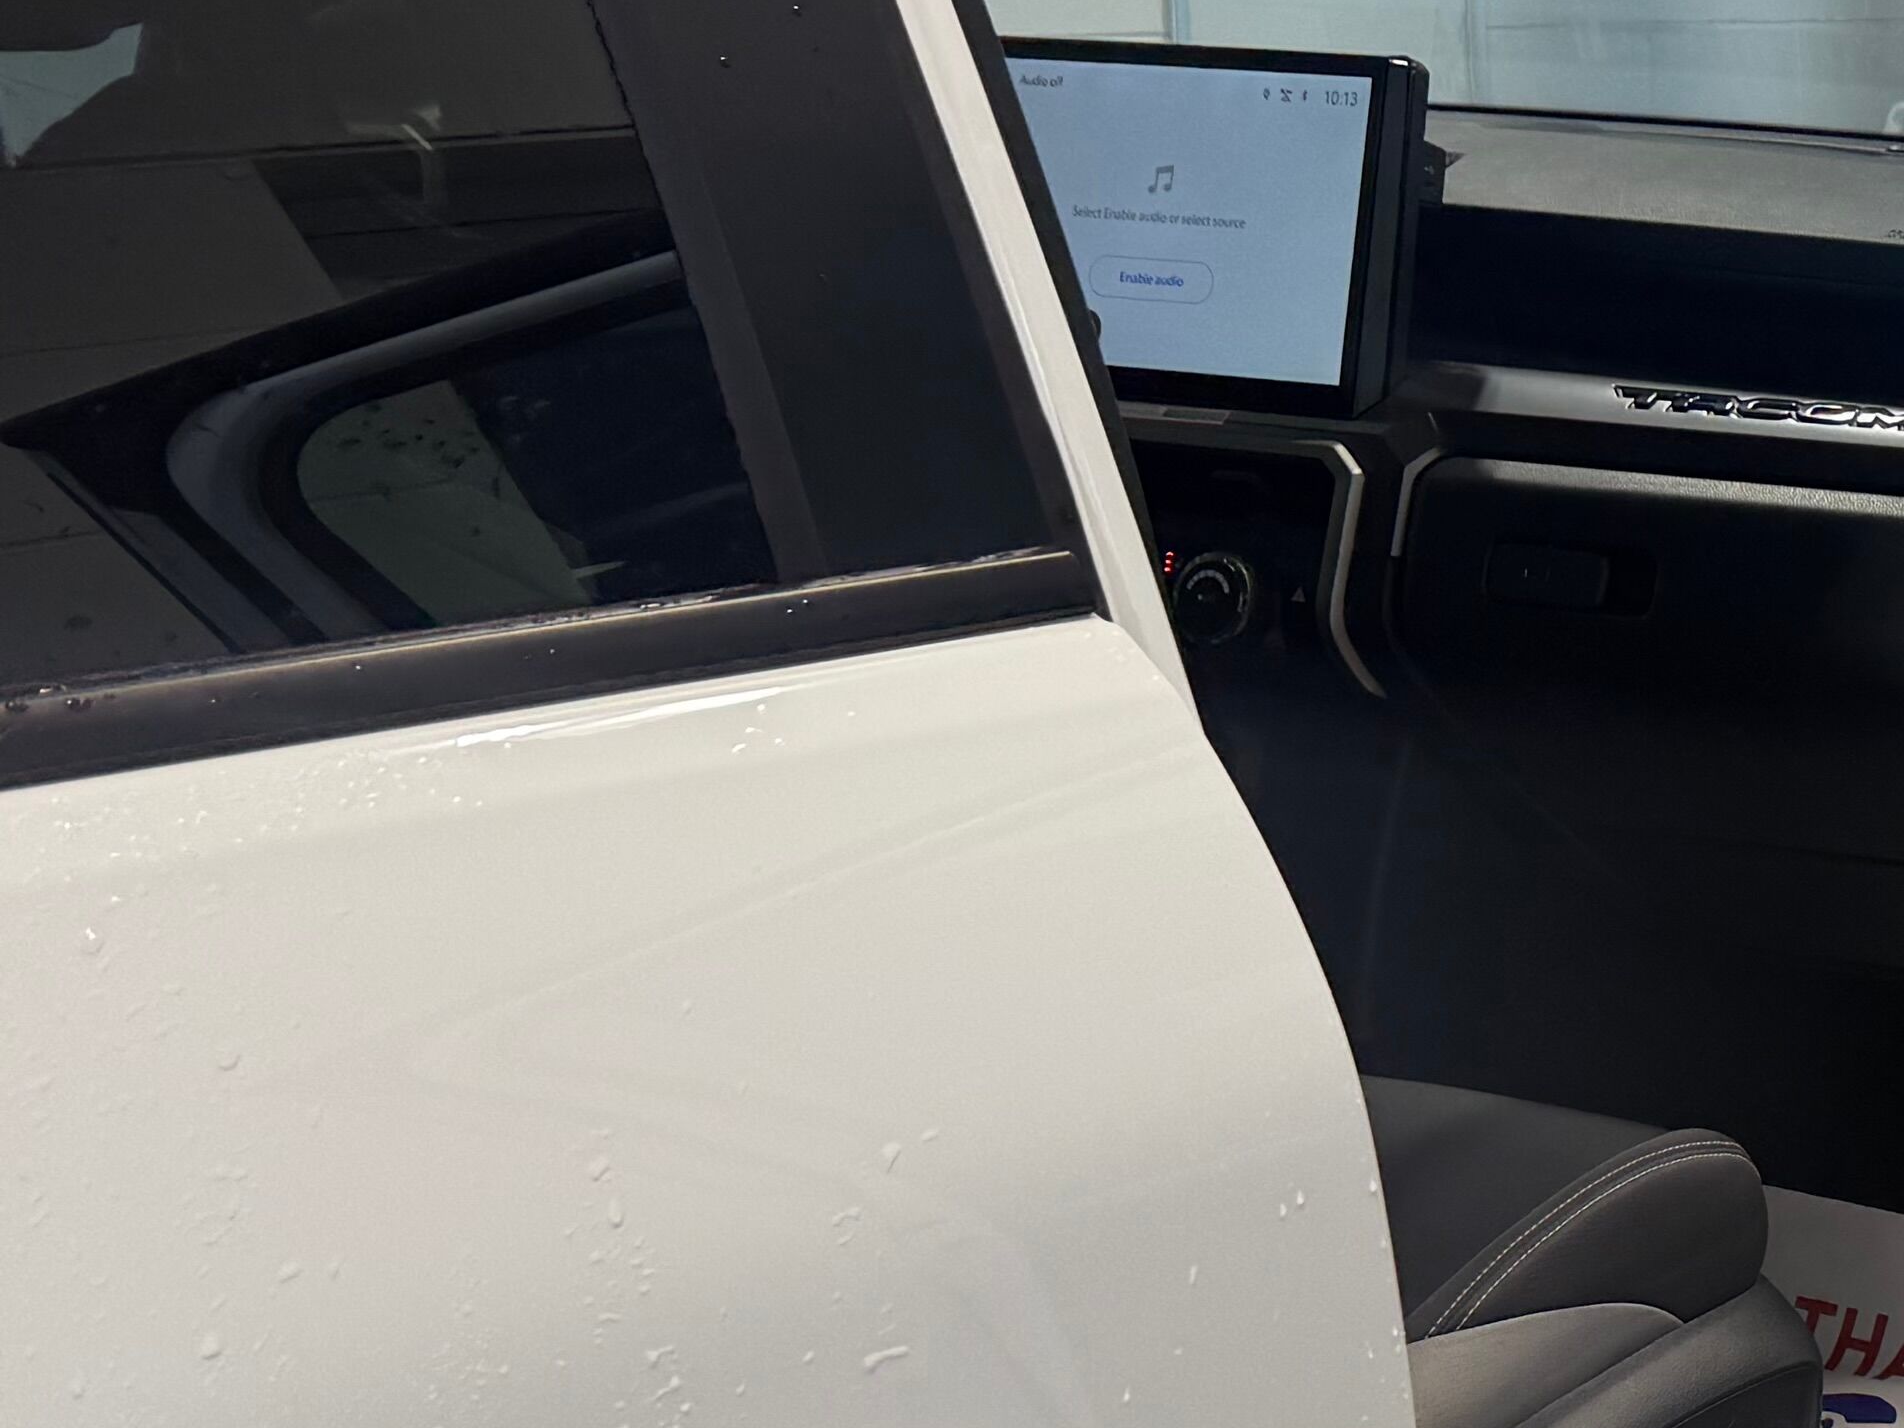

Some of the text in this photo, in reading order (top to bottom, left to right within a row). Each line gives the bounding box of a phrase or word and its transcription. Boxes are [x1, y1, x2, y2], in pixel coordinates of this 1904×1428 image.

[1325, 90, 1358, 106] 10:13
[1072, 205, 1247, 229] Select Enable audio or select source
[1119, 271, 1185, 288] Enable audio
